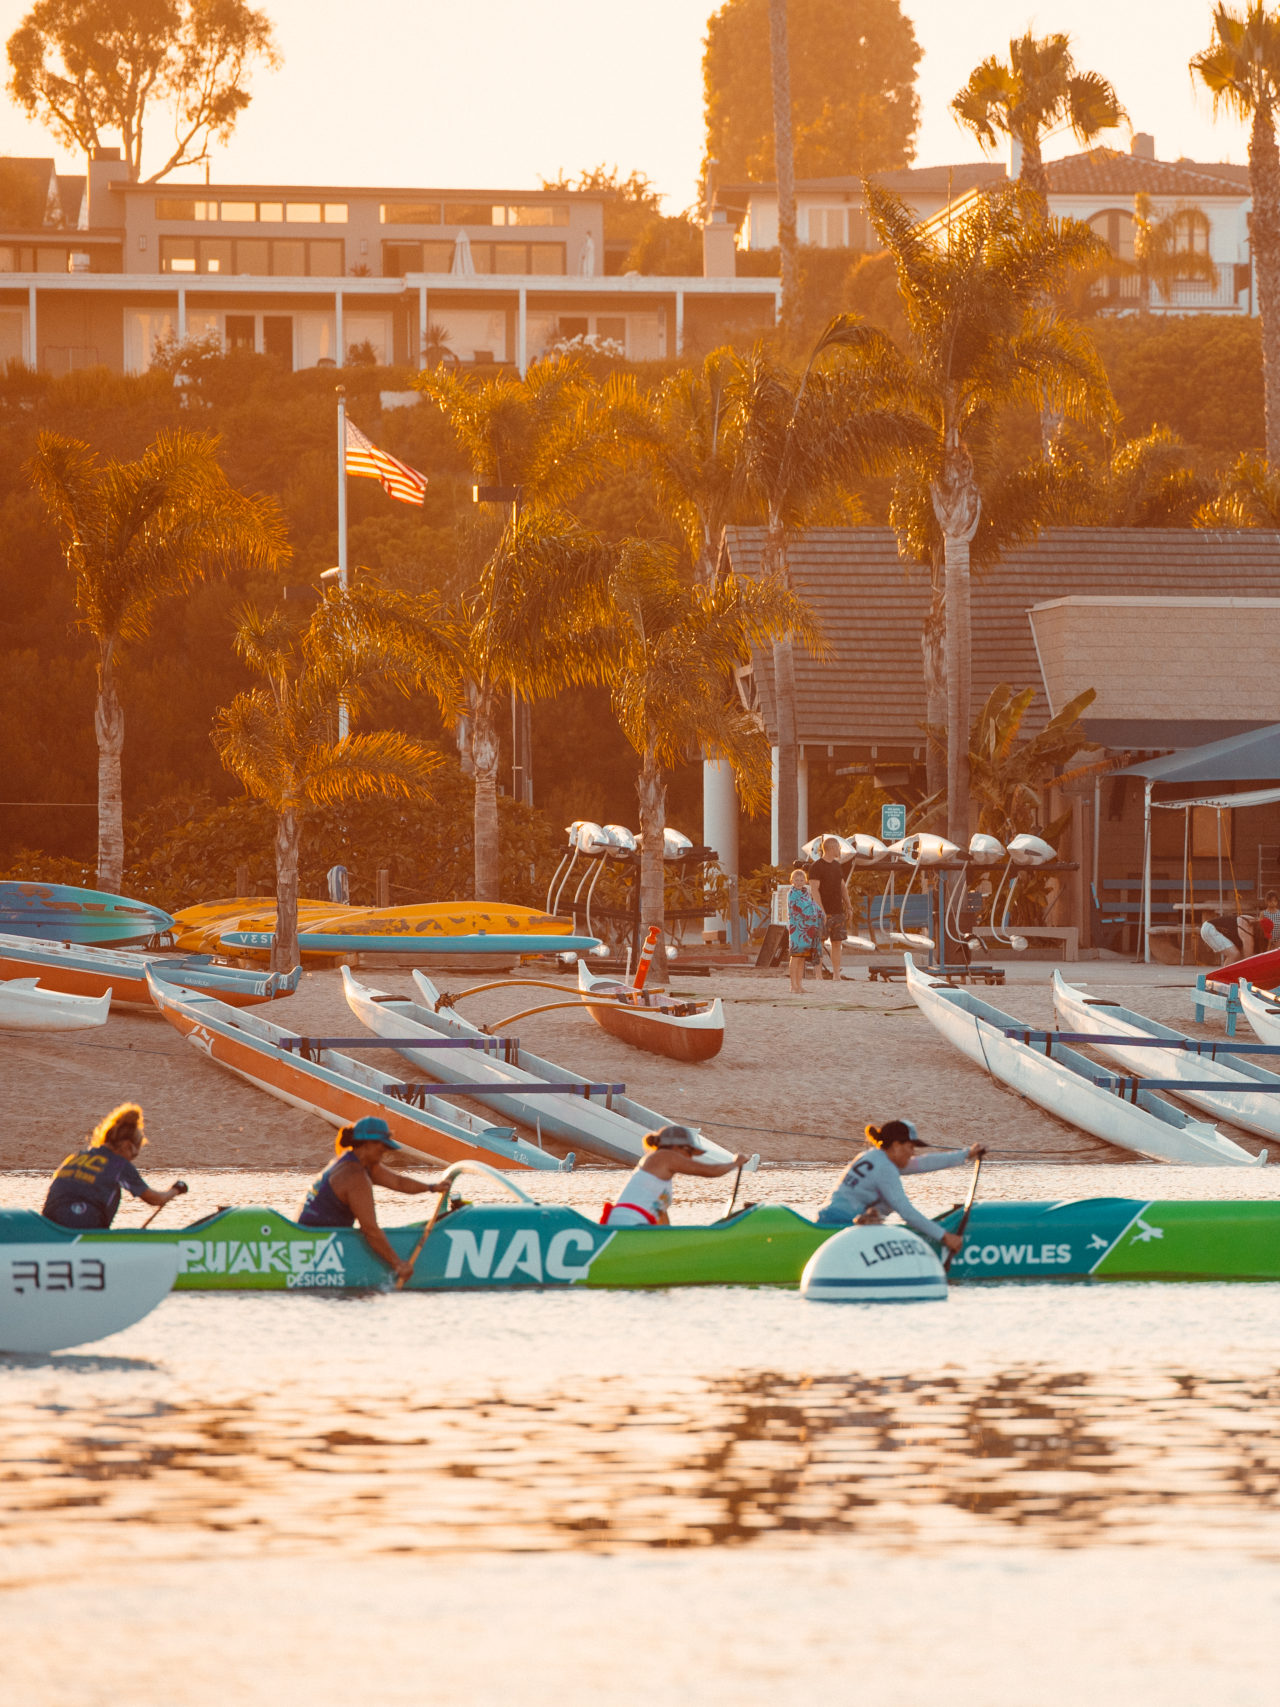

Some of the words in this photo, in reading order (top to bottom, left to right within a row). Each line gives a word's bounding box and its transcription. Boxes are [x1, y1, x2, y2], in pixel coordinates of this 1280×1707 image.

[68, 1154, 108, 1173] AC
[177, 1239, 346, 1274] PUAKEA
[444, 1228, 594, 1283] NAC
[286, 1273, 346, 1287] DESIGNS
